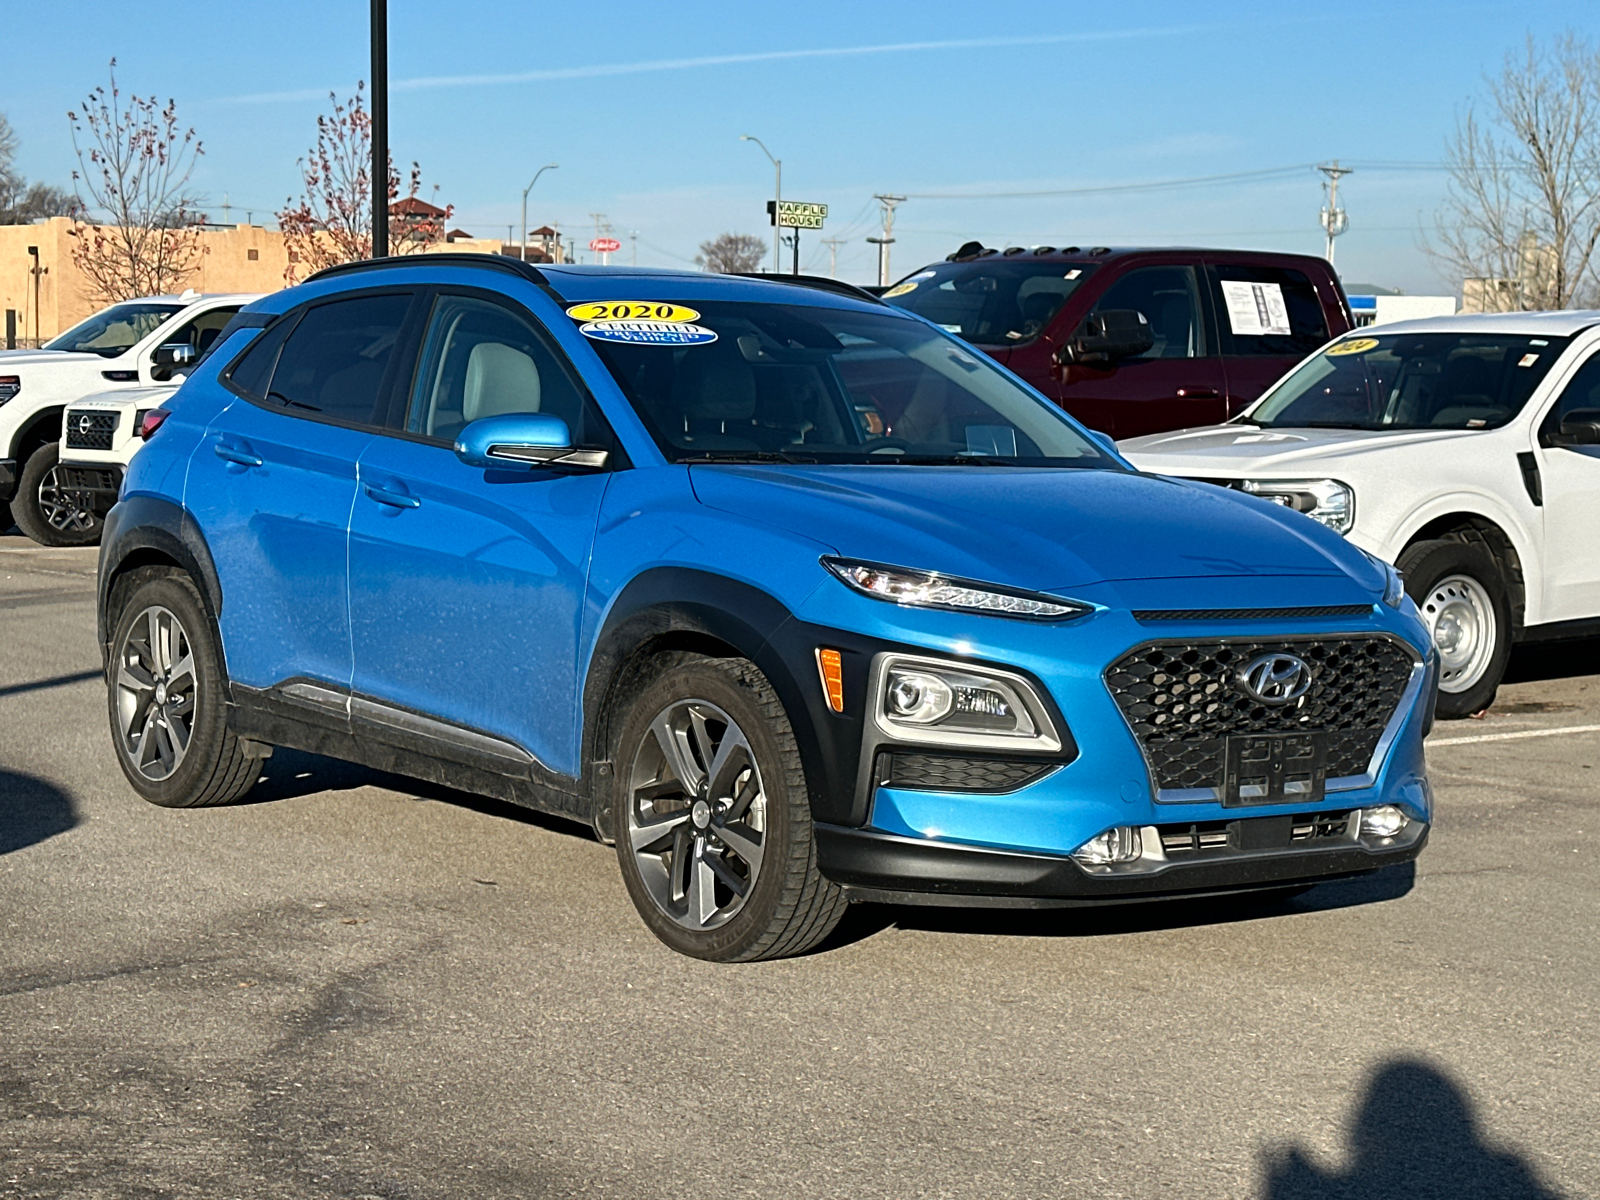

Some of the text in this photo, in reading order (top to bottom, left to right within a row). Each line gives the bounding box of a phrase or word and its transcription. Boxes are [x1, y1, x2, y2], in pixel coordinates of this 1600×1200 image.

[780, 216, 822, 227] HOUSE
[591, 305, 674, 319] 2020
[594, 322, 699, 334] CERTIFIED
